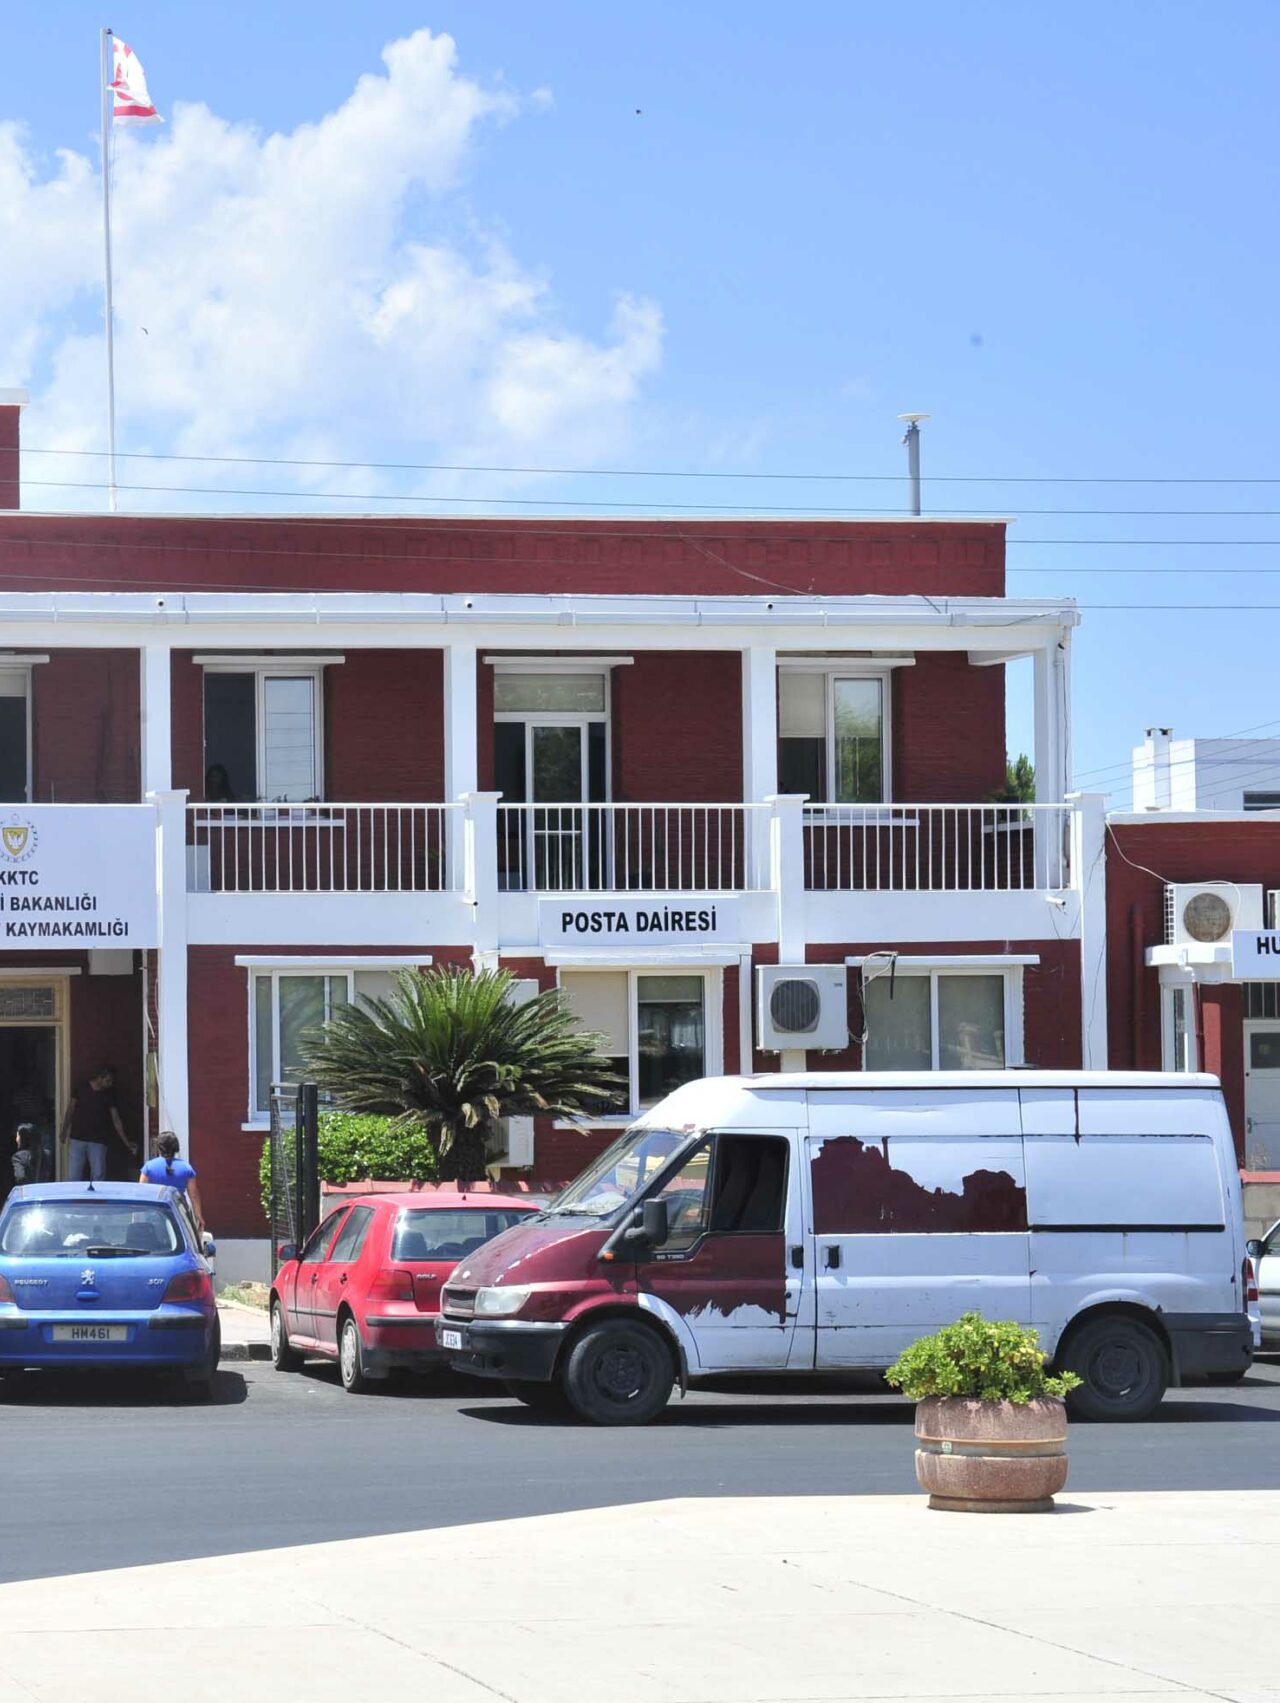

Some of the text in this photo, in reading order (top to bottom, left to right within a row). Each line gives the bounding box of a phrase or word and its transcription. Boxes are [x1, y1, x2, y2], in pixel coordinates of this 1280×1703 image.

[10, 893, 97, 911] BAKANLIĞI
[6, 918, 129, 937] KAYMAKAMLIĞI
[562, 906, 717, 932] POSTA DAİRESİ
[72, 1327, 110, 1340] HM461
